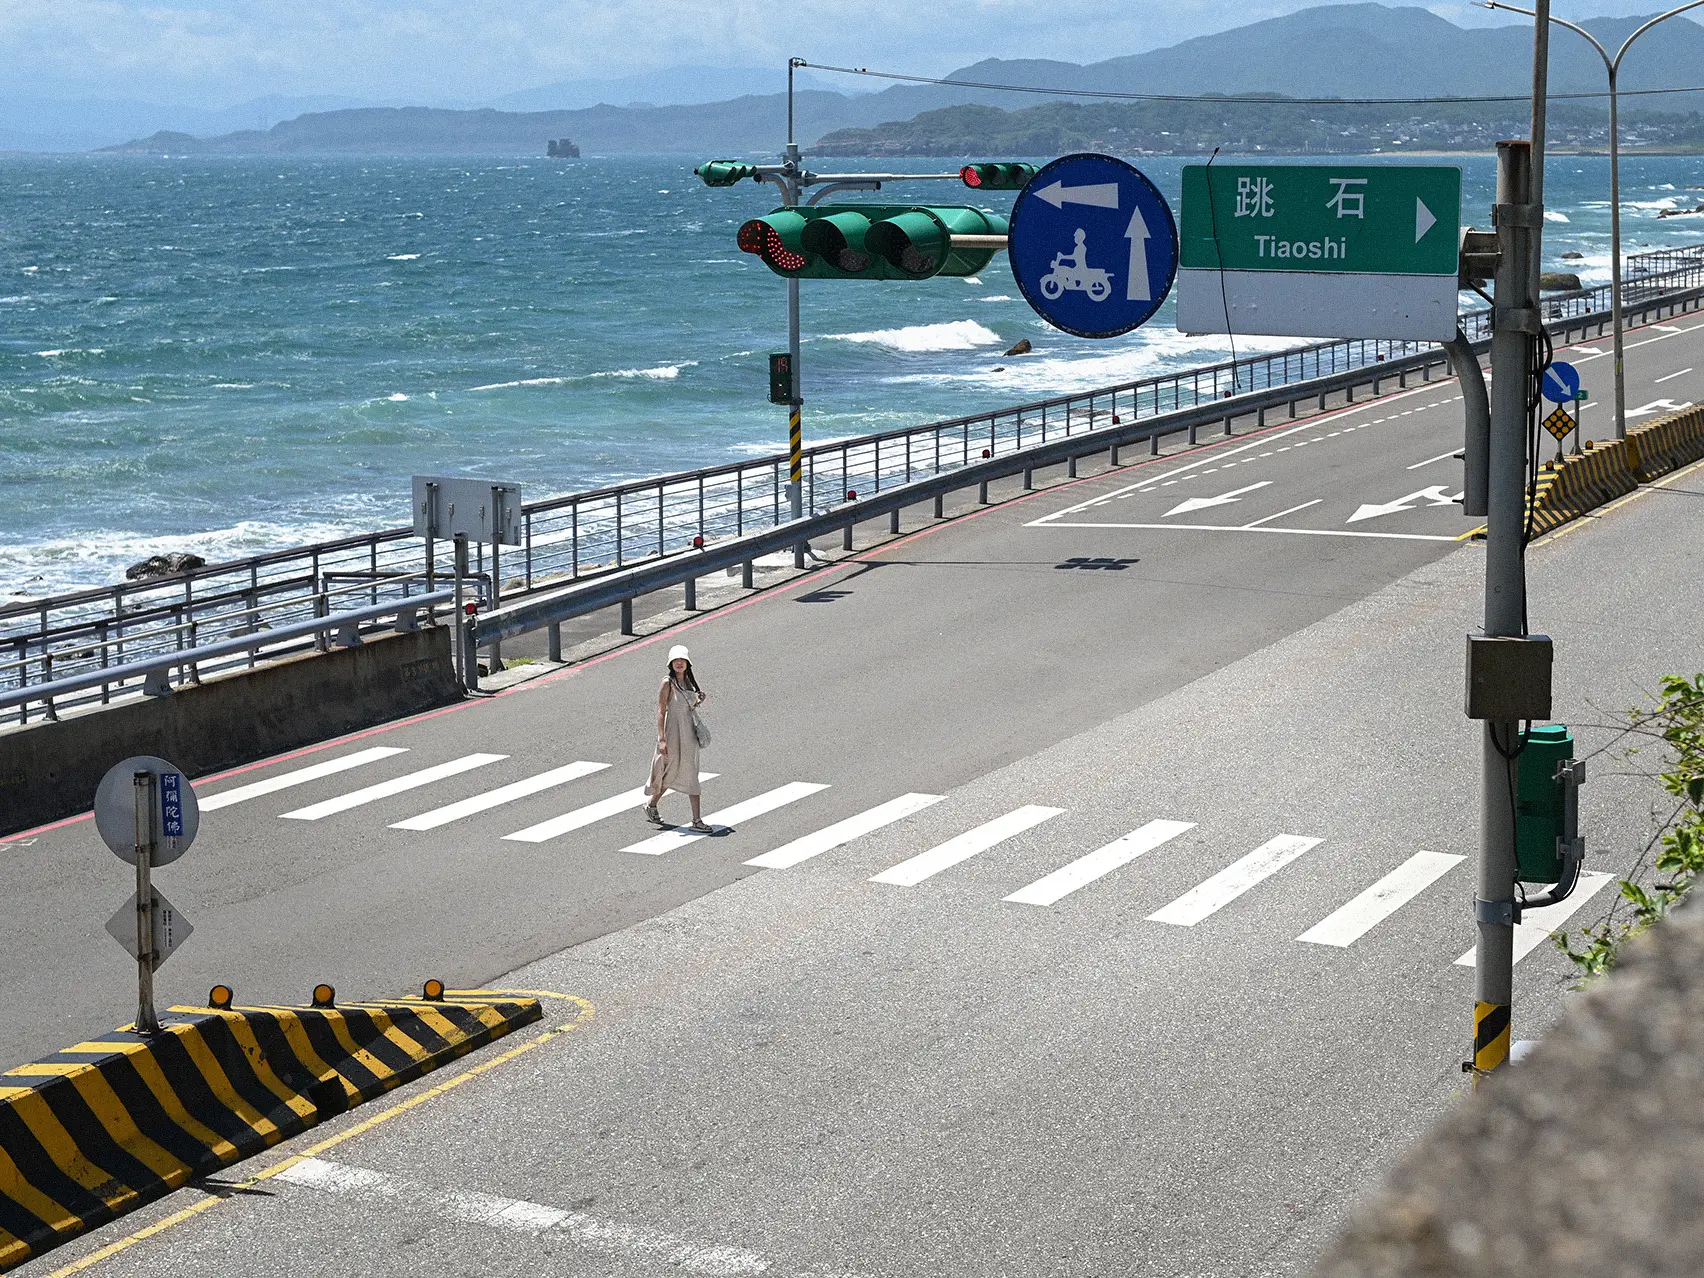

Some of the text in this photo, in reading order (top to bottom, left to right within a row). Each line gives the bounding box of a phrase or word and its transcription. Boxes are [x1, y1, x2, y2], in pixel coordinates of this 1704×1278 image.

[1234, 177, 1368, 219] 跳石
[1254, 235, 1346, 259] Tiaoshi
[164, 775, 181, 834] 阿彌陀佛
